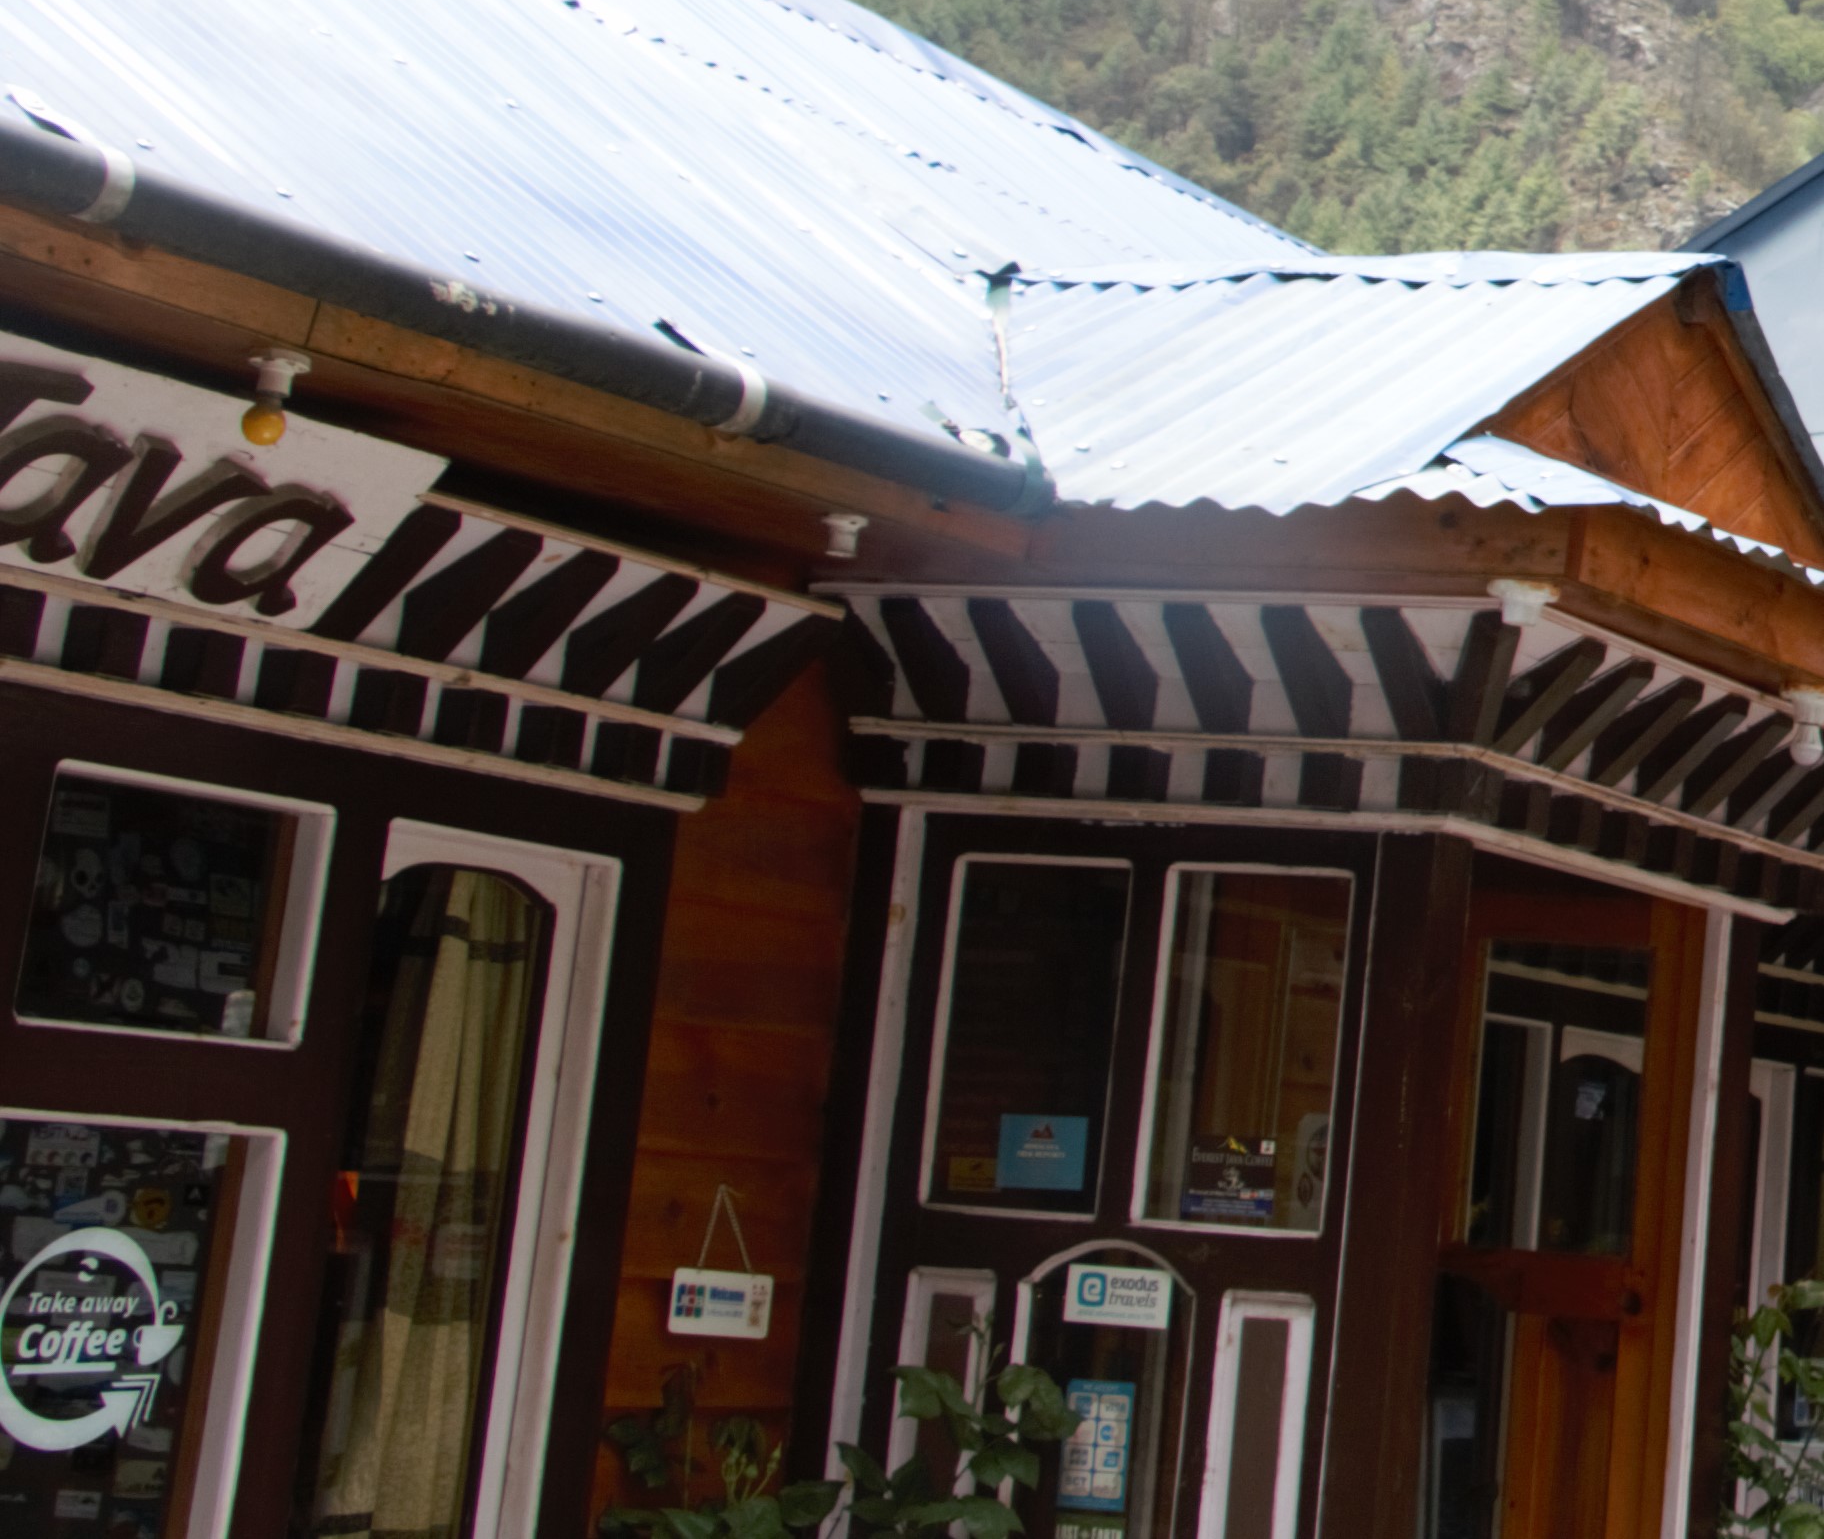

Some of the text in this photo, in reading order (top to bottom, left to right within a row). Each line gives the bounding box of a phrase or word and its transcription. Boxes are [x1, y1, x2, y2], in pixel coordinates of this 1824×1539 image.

[1110, 1274, 1159, 1293] exodus
[27, 1290, 140, 1319] Take away
[1108, 1290, 1158, 1309] travels
[17, 1320, 127, 1365] Coffee
